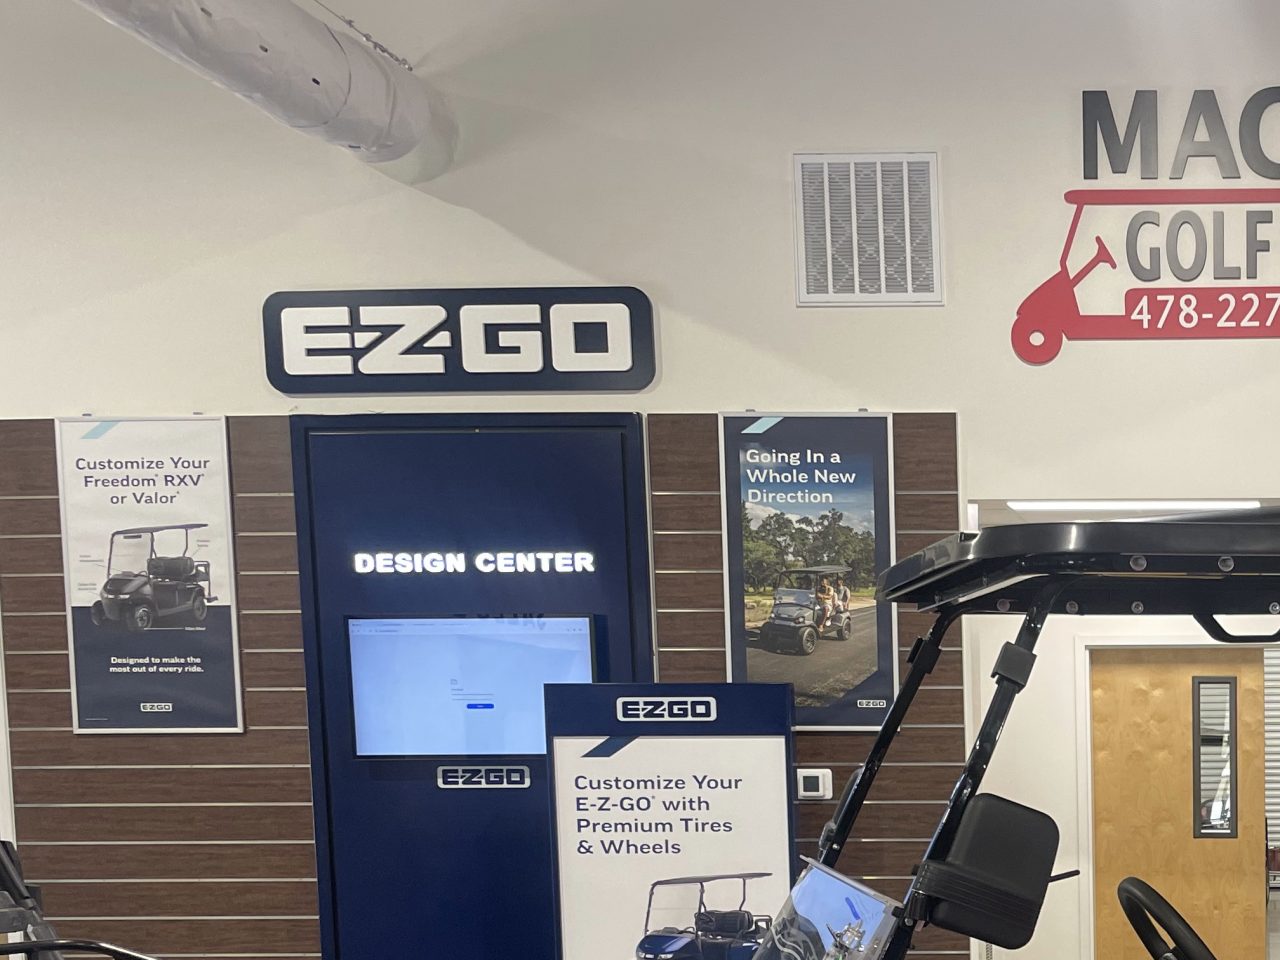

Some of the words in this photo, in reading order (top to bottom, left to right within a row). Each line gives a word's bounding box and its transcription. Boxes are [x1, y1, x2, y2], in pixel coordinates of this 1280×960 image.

[1125, 209, 1275, 283] GOLF
[75, 457, 165, 470] Customize
[169, 456, 210, 469] Your
[745, 449, 801, 466] Going
[806, 449, 827, 464] In
[830, 453, 841, 464] a
[84, 474, 158, 488] Freedom
[164, 474, 203, 487] RXV
[746, 468, 809, 484] Whole
[814, 469, 857, 484] New
[110, 494, 127, 505] or
[132, 491, 178, 504] Valor
[747, 488, 833, 504] Direction
[353, 552, 467, 574] DESIGN
[474, 551, 596, 573] CENTER
[110, 656, 150, 666] Designed
[151, 656, 160, 664] to
[161, 656, 186, 664] make
[187, 656, 202, 664] the
[148, 665, 157, 673] of
[158, 666, 183, 674] every
[184, 665, 204, 673] ride.
[574, 775, 686, 790] Customize
[692, 774, 743, 790] Your
[661, 795, 711, 811] with
[576, 818, 674, 833] Premium
[679, 817, 733, 833] Tires
[576, 839, 594, 855] &
[599, 838, 682, 854] Wheels
